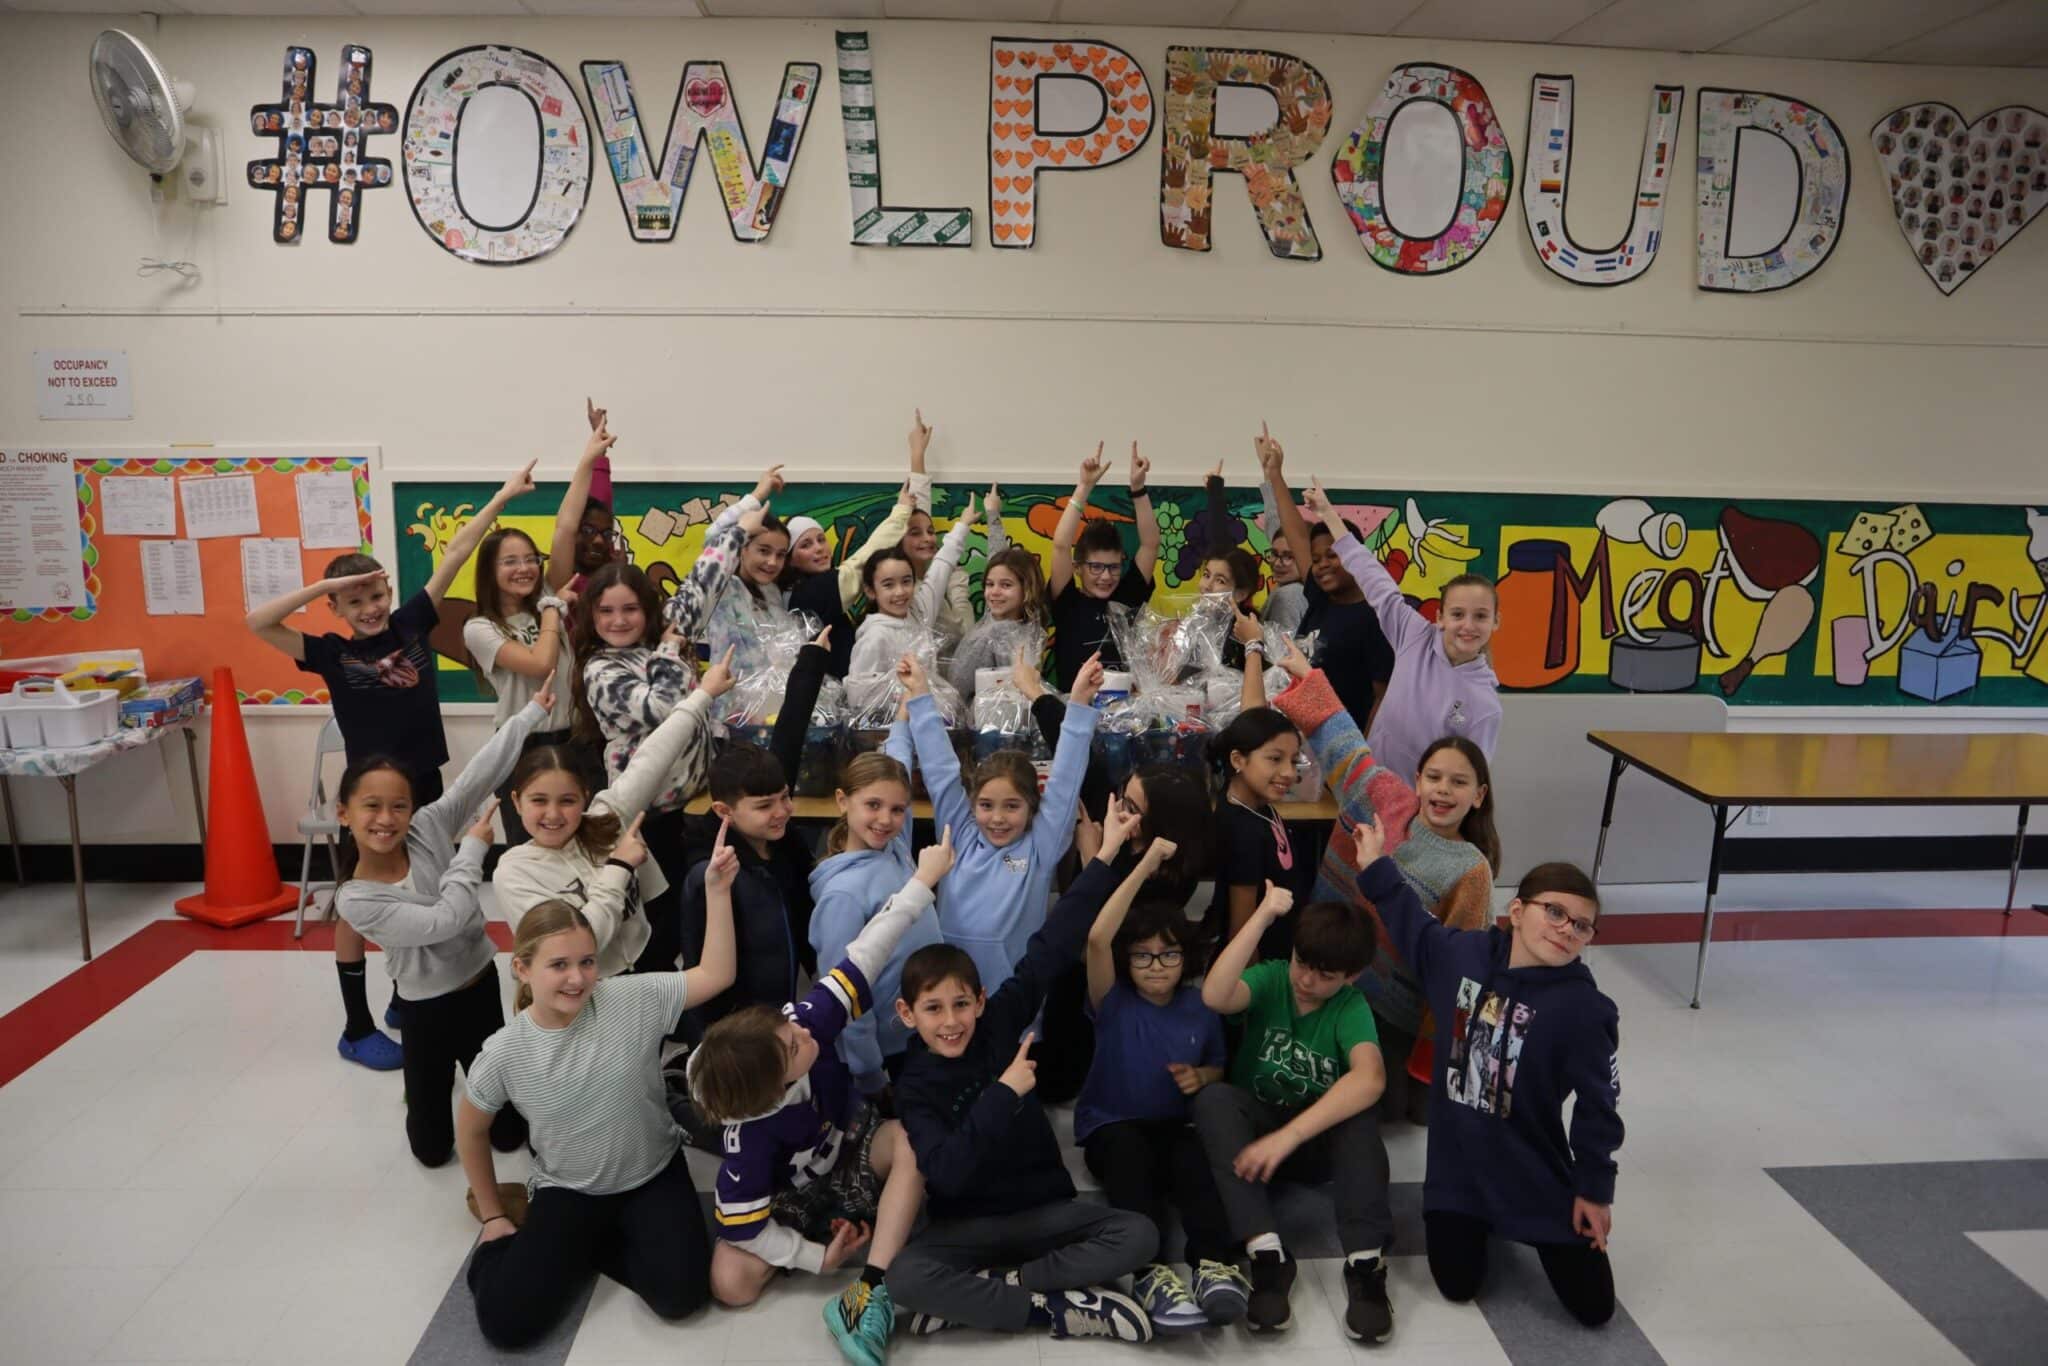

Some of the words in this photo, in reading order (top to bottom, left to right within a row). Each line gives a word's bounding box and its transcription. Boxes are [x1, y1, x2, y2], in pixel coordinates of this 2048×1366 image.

[248, 30, 1851, 293] #OWLPROUD
[53, 359, 109, 371] OCCUPANCY
[48, 376, 66, 388] NOT
[68, 376, 81, 388] TO
[83, 376, 118, 388] EXCEED
[65, 393, 95, 406] 250
[17, 452, 69, 464] CHOKING
[1545, 527, 1732, 670] Meat
[1849, 549, 2048, 662] Dairy
